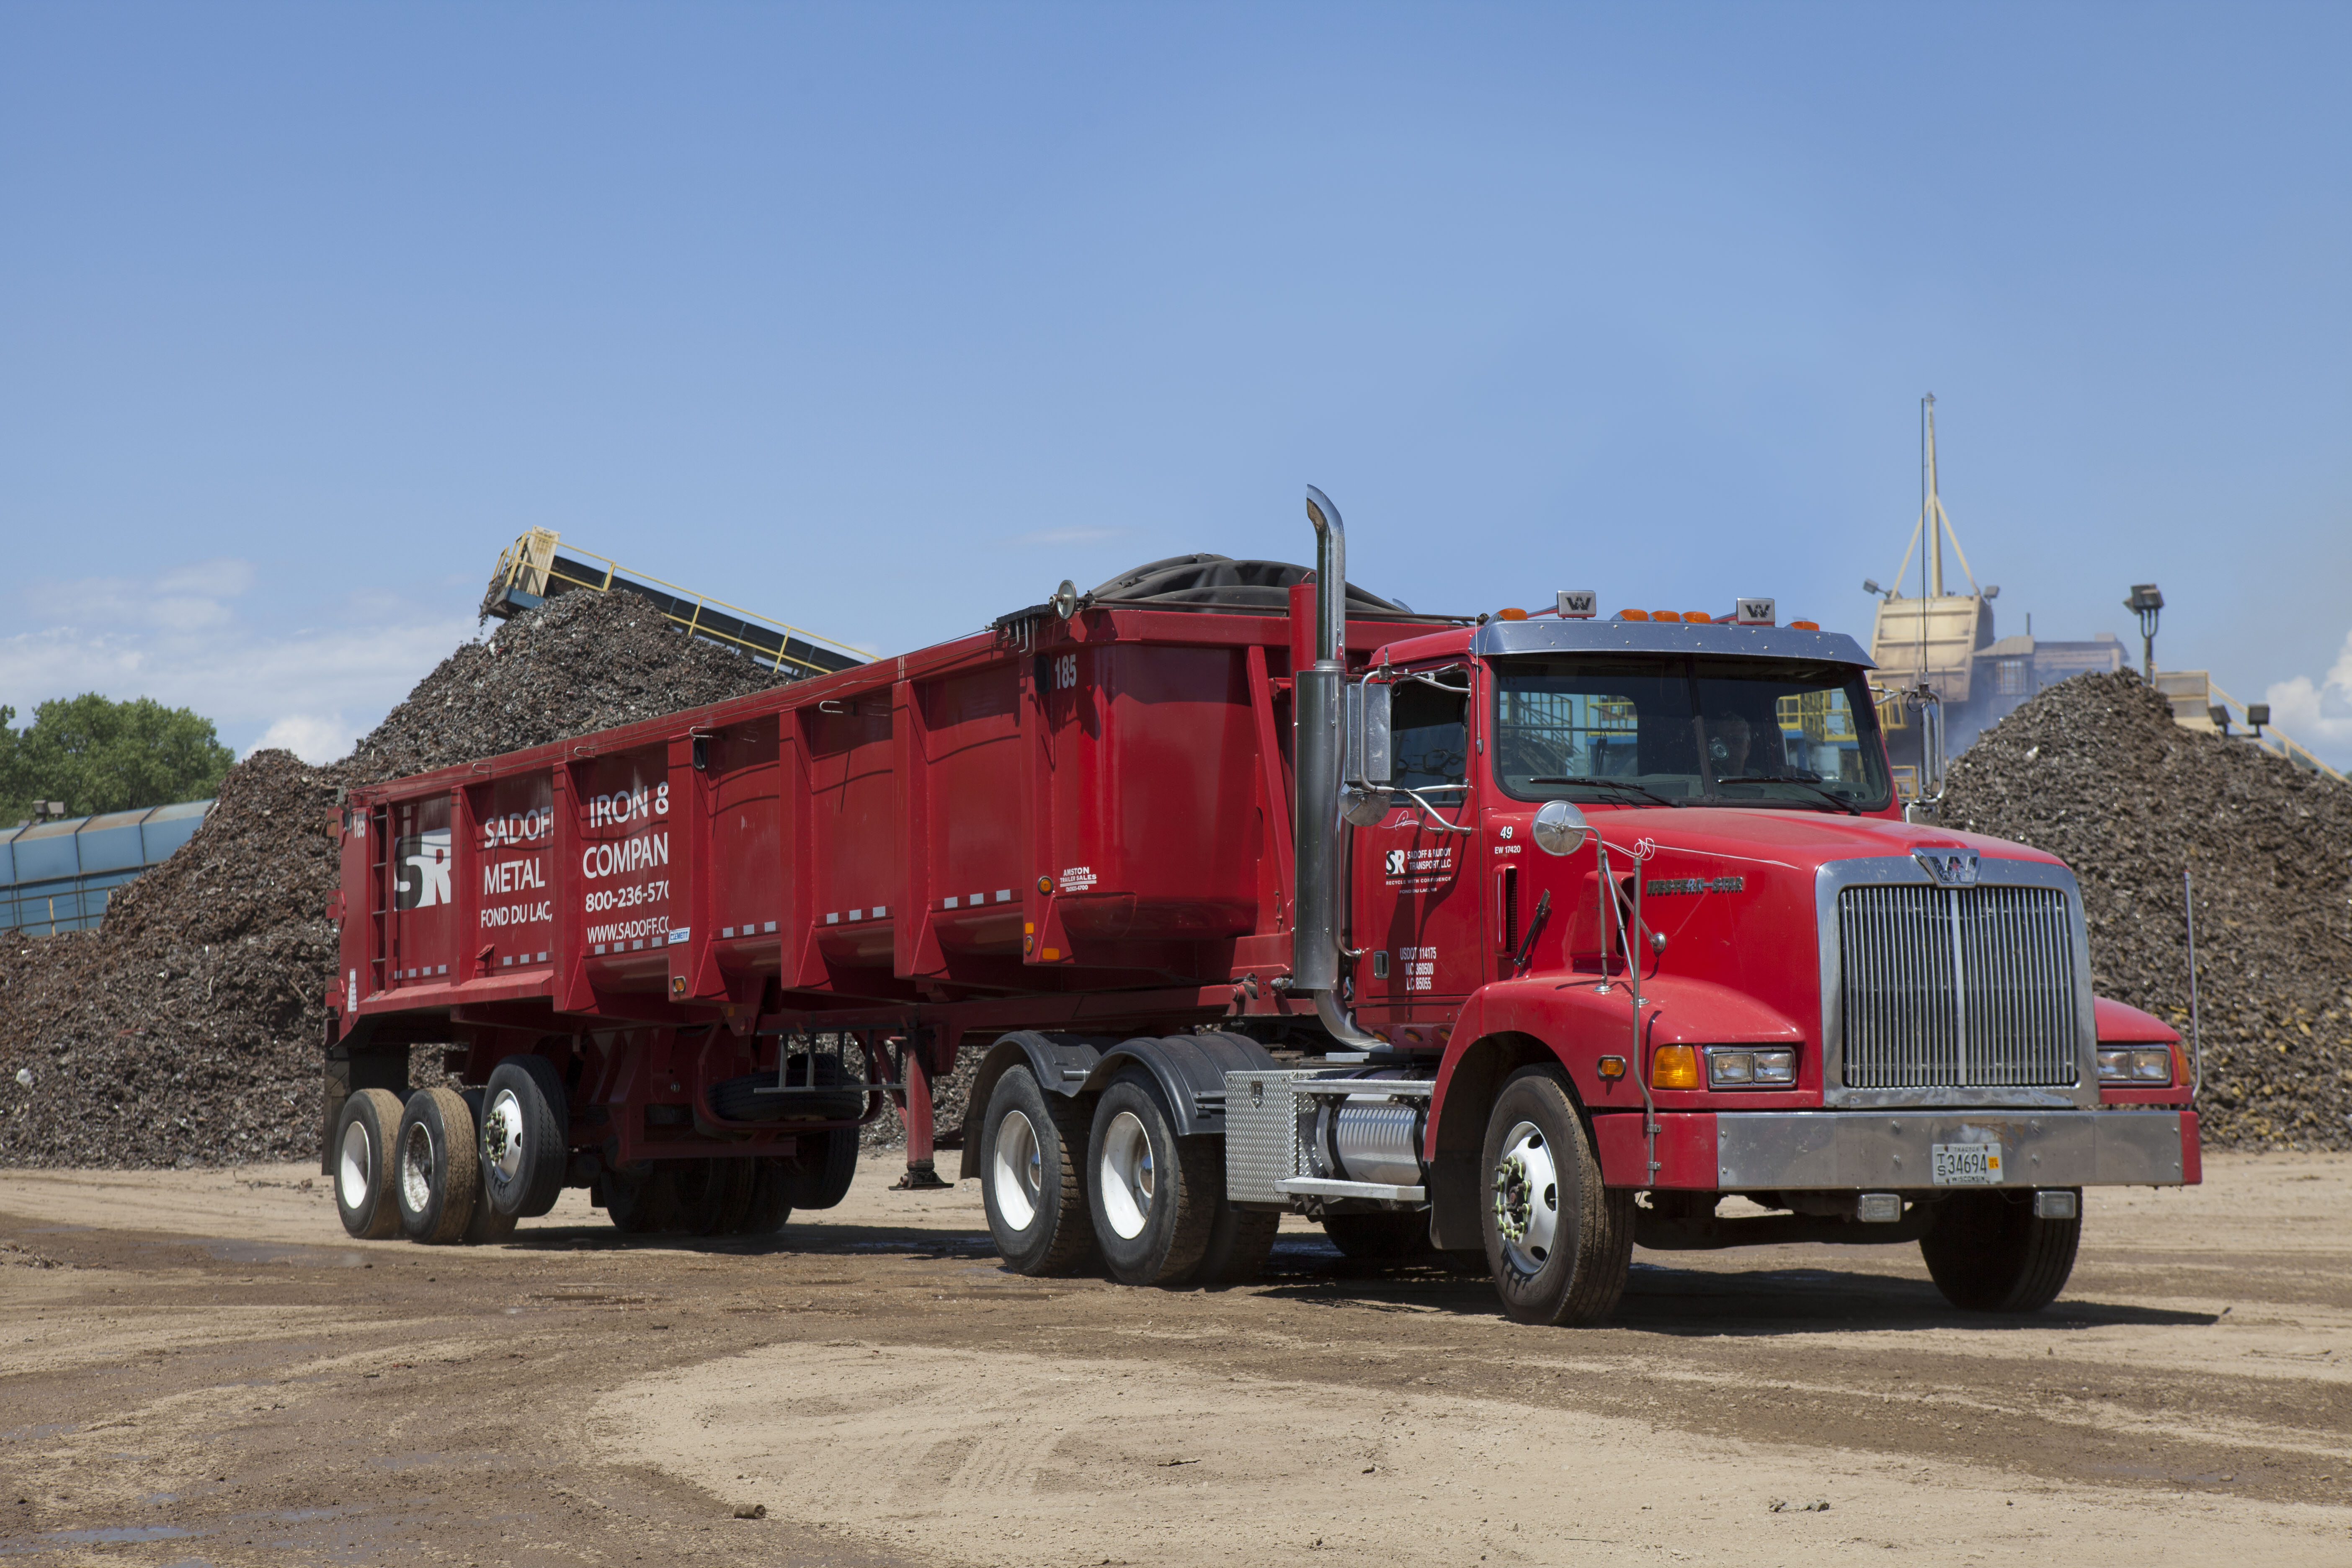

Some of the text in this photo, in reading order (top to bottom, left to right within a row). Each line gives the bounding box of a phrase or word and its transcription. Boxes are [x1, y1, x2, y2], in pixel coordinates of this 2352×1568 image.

[1055, 654, 1076, 689] 185
[590, 785, 648, 828] IRON
[655, 781, 668, 815] &
[353, 814, 365, 838] 185
[1500, 825, 1513, 840] 49
[1407, 849, 1427, 859] SADOFF
[1433, 847, 1451, 857] RUDOY
[1505, 845, 1521, 854] 17420
[1386, 850, 1405, 874] SR
[485, 858, 545, 895] METAL
[1063, 867, 1089, 877] AMSTON
[1647, 877, 1743, 896] WESTERN STAR
[481, 900, 552, 928] FOND DU LAC,
[670, 931, 688, 940] CLEMENT
[1400, 947, 1436, 960] USDOT 114175
[1405, 962, 1434, 975] MC 360500
[1406, 977, 1431, 990] LC 85055
[1947, 1153, 1986, 1173] 34694
